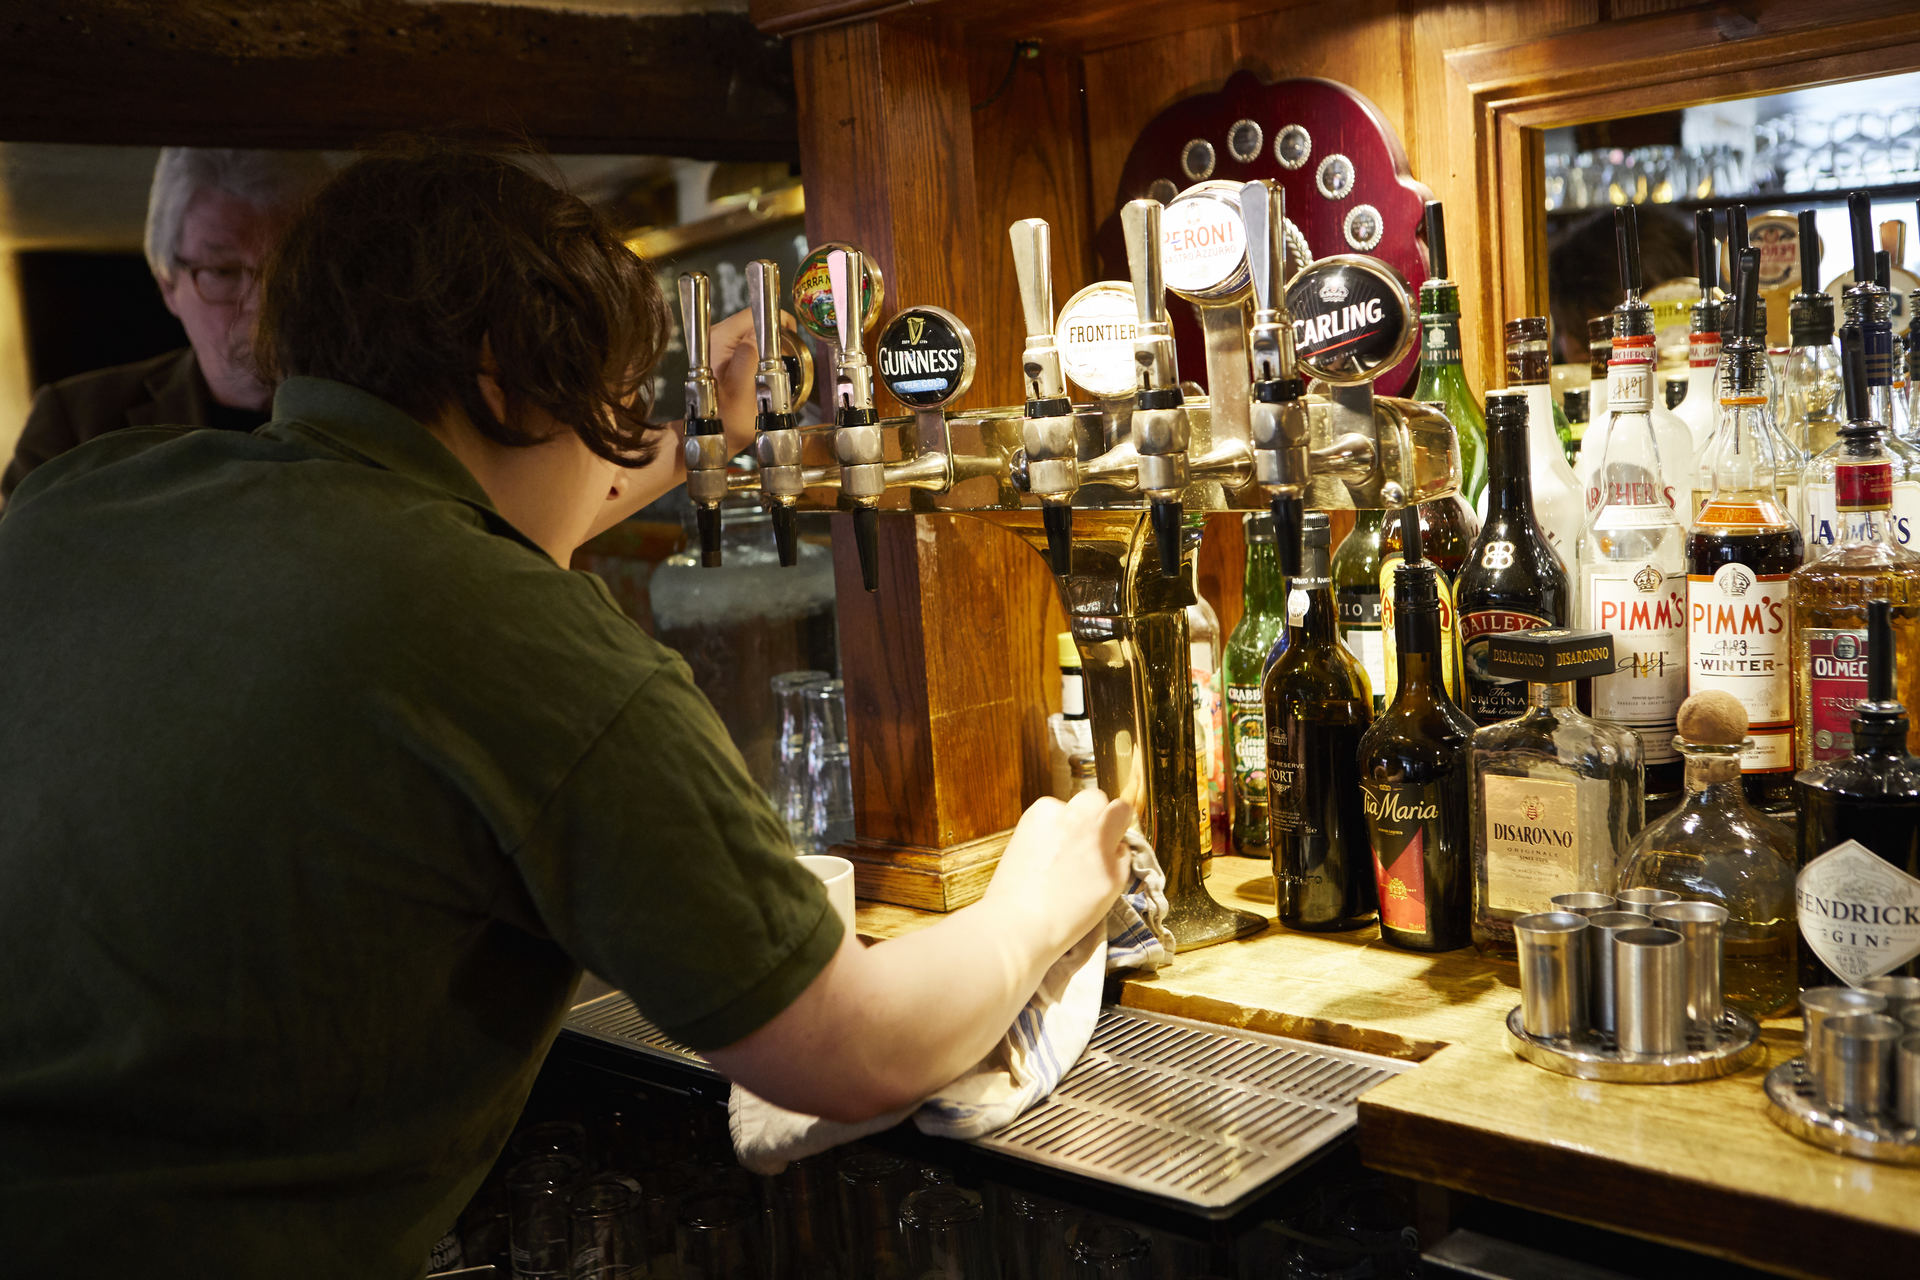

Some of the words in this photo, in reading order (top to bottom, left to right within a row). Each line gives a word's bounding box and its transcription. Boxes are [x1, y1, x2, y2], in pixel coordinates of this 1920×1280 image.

[1069, 324, 1136, 343] FRONTIER
[1292, 298, 1382, 350] CARLING
[879, 347, 958, 376] GUINNESS
[1601, 592, 1684, 631] PIMM'S
[1693, 596, 1784, 635] PIMM'S
[1493, 649, 1545, 668] DISARONNO
[1556, 646, 1609, 667] DISARONNO
[1815, 658, 1868, 677] OLMEC
[1470, 694, 1526, 706] ORIGINA
[1376, 791, 1437, 823] Maria
[1494, 822, 1573, 849] DISARONNO
[1506, 847, 1559, 858] ORIGINALE
[1832, 931, 1878, 948] GIN
